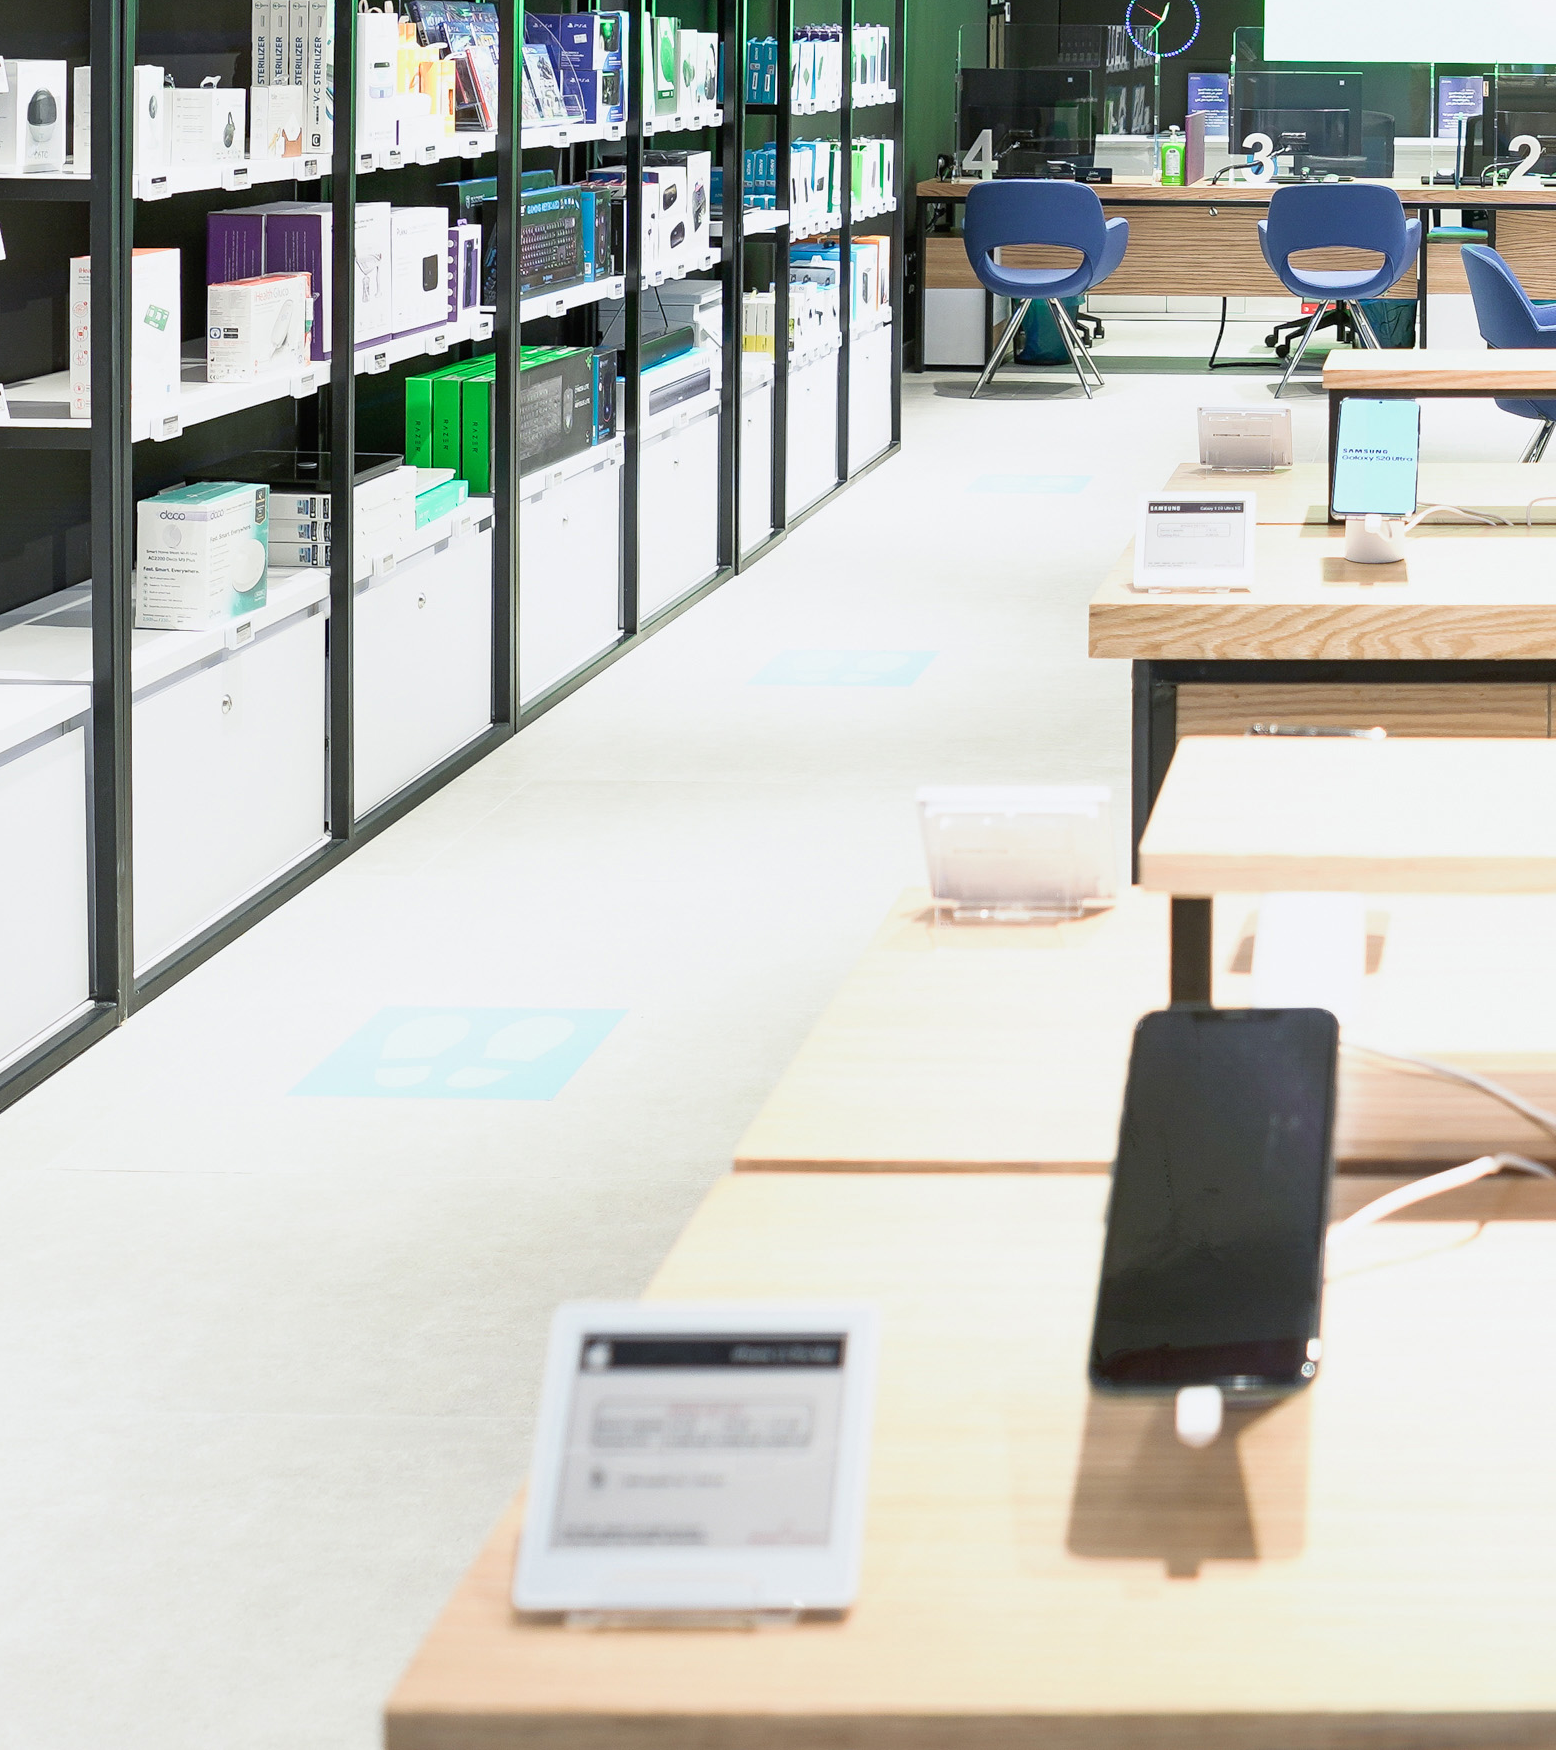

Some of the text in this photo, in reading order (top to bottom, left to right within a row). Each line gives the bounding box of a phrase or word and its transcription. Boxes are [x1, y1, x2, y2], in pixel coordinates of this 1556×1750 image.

[257, 35, 265, 85] STERILIZER
[275, 36, 283, 85] STERILIZER
[294, 36, 303, 85] STERILIZER
[313, 36, 322, 86] STERILIZER
[962, 129, 999, 180] 4
[1241, 133, 1276, 183] 3
[1505, 135, 1543, 186] 2
[526, 200, 560, 215] GAMING KEYBOARD
[254, 287, 289, 301] iHealth Gluco
[1341, 454, 1413, 462] Galaxy S20 Ultra
[1342, 447, 1389, 455] SAMSUNG
[159, 510, 186, 521] deco
[1149, 504, 1181, 512] SAMSUNG
[143, 565, 154, 573] Fast.
[170, 567, 200, 575] Everywhere.
